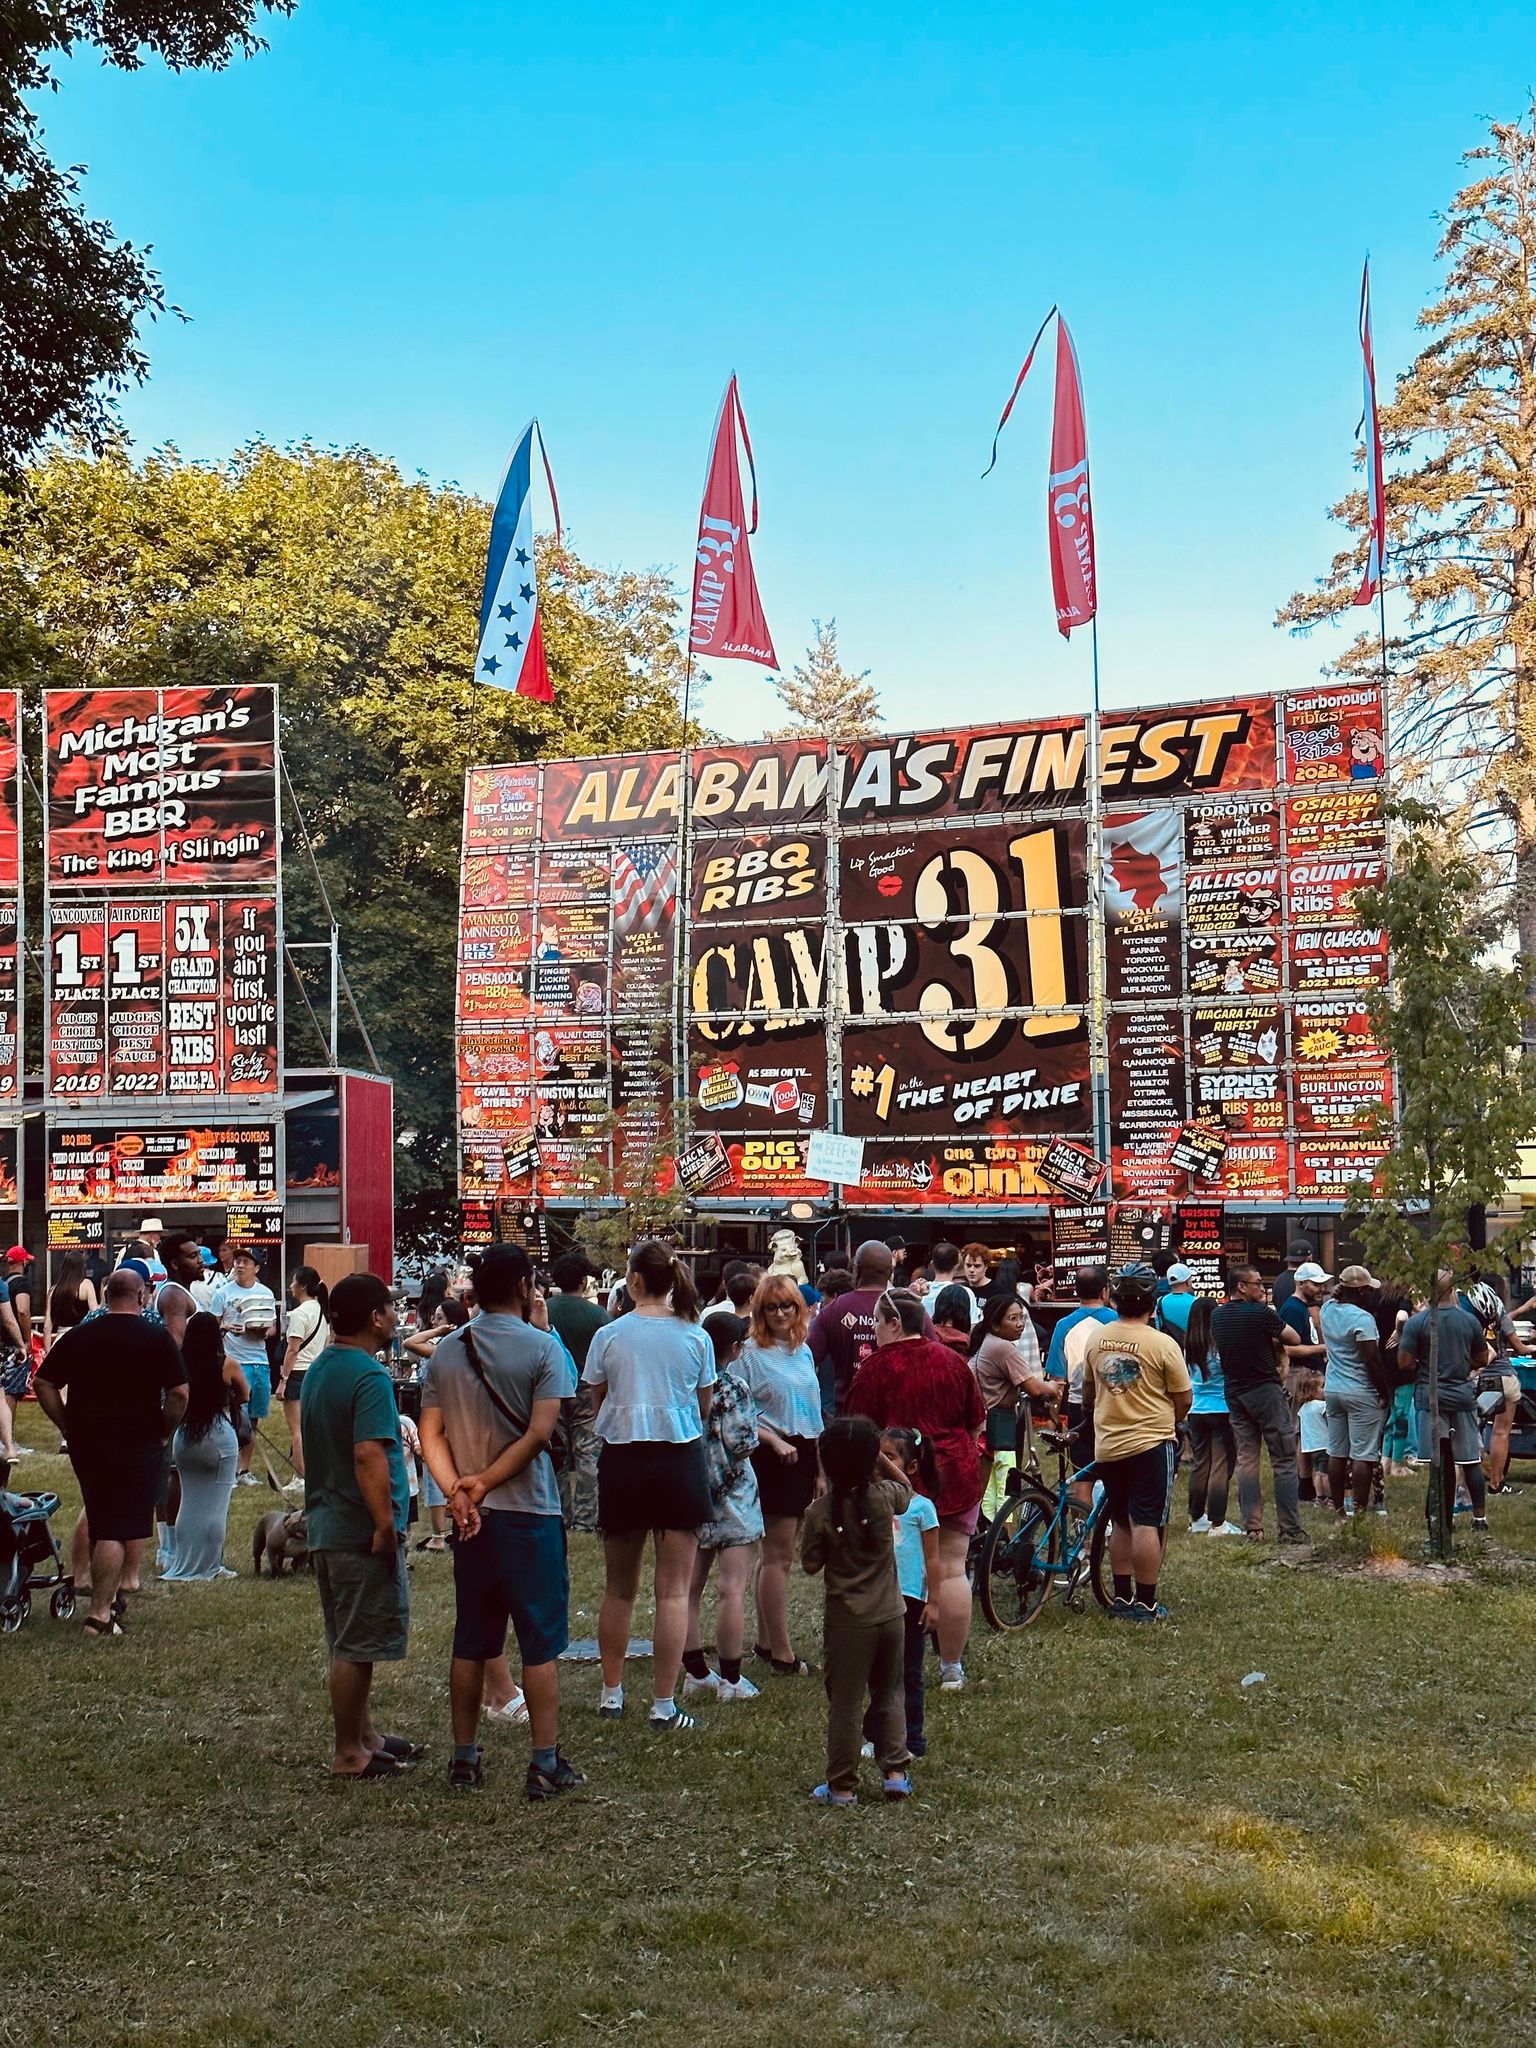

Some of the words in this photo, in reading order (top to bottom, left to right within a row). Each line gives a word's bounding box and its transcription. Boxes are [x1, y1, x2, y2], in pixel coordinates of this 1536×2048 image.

[697, 514, 740, 573] 31
[690, 570, 726, 646] CAMP
[720, 641, 771, 659] ALABAMA
[1286, 688, 1377, 711] Scarborough
[1292, 709, 1345, 726] ribfest
[59, 699, 250, 759] Michigan's
[1288, 725, 1340, 748] Best
[1294, 742, 1343, 764] Ribs
[103, 742, 199, 780] Most
[565, 739, 950, 825] ALABAMA'S
[960, 713, 1242, 800] FINEST
[1294, 764, 1339, 781] 2022
[75, 769, 222, 814] Famous
[474, 803, 499, 815] BEST
[501, 802, 534, 813] SAUCE
[1292, 792, 1378, 811] OSHAWA
[1190, 802, 1273, 818] TORONTO
[1299, 807, 1374, 825] RIBEST
[104, 800, 187, 837] BBQ
[1221, 824, 1270, 838] WINNER
[1291, 826, 1319, 836] 1ST
[1323, 820, 1384, 833] PLACE
[1193, 846, 1231, 856] BEST
[1236, 843, 1273, 853] RIBS
[61, 854, 98, 874] The
[107, 849, 153, 869] King
[703, 843, 810, 884] BBQ
[869, 861, 895, 877] Good
[1290, 860, 1382, 885] QUINTE
[1188, 870, 1278, 891] ALLISON
[700, 869, 816, 914] RIBS
[1189, 890, 1240, 904] RIBFEST
[1189, 905, 1207, 914] 1ST
[1207, 902, 1239, 912] PLACE
[1291, 895, 1334, 913] Ribs
[51, 909, 104, 925] VANCOUVER
[110, 907, 160, 922] AIRDRIE
[242, 908, 257, 931] If
[467, 912, 519, 925] MANKATO
[1118, 907, 1166, 919] WALL
[1130, 915, 1153, 924] OF
[1188, 914, 1212, 923] RIBS
[1214, 912, 1239, 921] 2023
[174, 906, 210, 952] 5X
[462, 926, 521, 938] MINNESOTA
[1114, 920, 1169, 935] FLAME
[1193, 921, 1236, 931] JUDGED
[625, 931, 661, 942] WALL
[691, 925, 906, 1039] CAMP
[915, 829, 1081, 1052] 31
[1190, 935, 1276, 950] OTTAWA
[1295, 932, 1322, 951] NEW
[1322, 928, 1381, 949] GLASGOW
[234, 934, 265, 955] you
[464, 942, 496, 951] BEST
[464, 950, 496, 960] RIBS
[1125, 956, 1166, 964] TORONTO
[1295, 958, 1322, 967] 1ST
[1327, 954, 1383, 965] PLACE
[171, 957, 214, 978] GRAND
[233, 954, 267, 976] ain't
[1120, 965, 1170, 974] BROCKVILLE
[1307, 964, 1371, 978] RIBS
[465, 972, 523, 985] PENSACOLA
[1126, 975, 1165, 984] WINDSOR
[1298, 979, 1329, 988] 2022
[1332, 976, 1380, 986] JUDGED
[111, 987, 160, 1000] PLACE
[169, 978, 217, 995] CHAMPION
[233, 978, 269, 1002] first,
[55, 987, 101, 1001] PLACE
[169, 1002, 216, 1030] BEST
[227, 1002, 275, 1025] you're
[1195, 1008, 1243, 1020] NIAGARA
[1245, 1007, 1278, 1018] FALLS
[59, 1026, 95, 1038] CHOICE
[112, 1025, 159, 1036] CHOICE
[1127, 1024, 1169, 1034] KINGSTON
[1213, 1020, 1259, 1031] RIBFEST
[235, 1025, 267, 1046] last!
[52, 1039, 78, 1051] BEST
[79, 1039, 103, 1051] RIBS
[120, 1039, 152, 1049] BEST
[171, 1036, 214, 1065] RIBS
[116, 1051, 156, 1062] SAUCE
[53, 1076, 101, 1092] 2018
[114, 1074, 159, 1090] 2022
[1199, 1073, 1278, 1089] SYDNEY
[1300, 1080, 1385, 1093] BURLINGTON
[474, 1088, 512, 1097] GRAVEL
[514, 1087, 530, 1096] PIT
[537, 1088, 574, 1098] WINSTON
[579, 1087, 606, 1098] SALEM
[747, 1088, 770, 1100] OWN
[774, 1086, 797, 1102] food
[851, 1063, 896, 1121] #1
[910, 1076, 924, 1088] the
[897, 1086, 945, 1111] THE
[952, 1069, 1037, 1100] HEART
[1201, 1086, 1277, 1101] RIBFEST
[481, 1098, 524, 1108] RIBFEST
[952, 1097, 996, 1122] OF
[1001, 1082, 1081, 1115] DIXIE
[1300, 1096, 1326, 1104] 1ST
[1330, 1094, 1382, 1102] PLACE
[1222, 1102, 1248, 1115] RIBS
[1253, 1102, 1283, 1113] 2018
[1252, 1115, 1284, 1128] 2022
[1130, 1132, 1172, 1140] MARKHAM
[745, 1141, 795, 1155] PIG
[1299, 1140, 1390, 1153] BOWMANVILLE
[681, 1154, 711, 1178] CHEESE
[741, 1156, 800, 1170] OUT
[1049, 1153, 1086, 1177] CHEESE
[1226, 1172, 1239, 1189] 3
[1240, 1176, 1280, 1187] WINNER
[1241, 1170, 1265, 1179] TIME
[1315, 1169, 1374, 1183] RIBS
[1130, 1179, 1175, 1187] ANCASTER
[1296, 1185, 1319, 1195] 2019
[1321, 1185, 1346, 1195] 2022
[1055, 1208, 1082, 1218] GRAND
[1084, 1206, 1106, 1216] SLAM
[1180, 1209, 1220, 1217] BRISKET
[87, 1222, 103, 1238] $155
[265, 1217, 281, 1233] $68
[1085, 1219, 1104, 1227] $46
[1186, 1221, 1198, 1229] by
[1200, 1220, 1216, 1228] the
[1183, 1230, 1219, 1239] POUND
[1182, 1241, 1221, 1250] $24.00
[1055, 1256, 1075, 1267] HAPPY
[1076, 1255, 1107, 1266] CAMPERS
